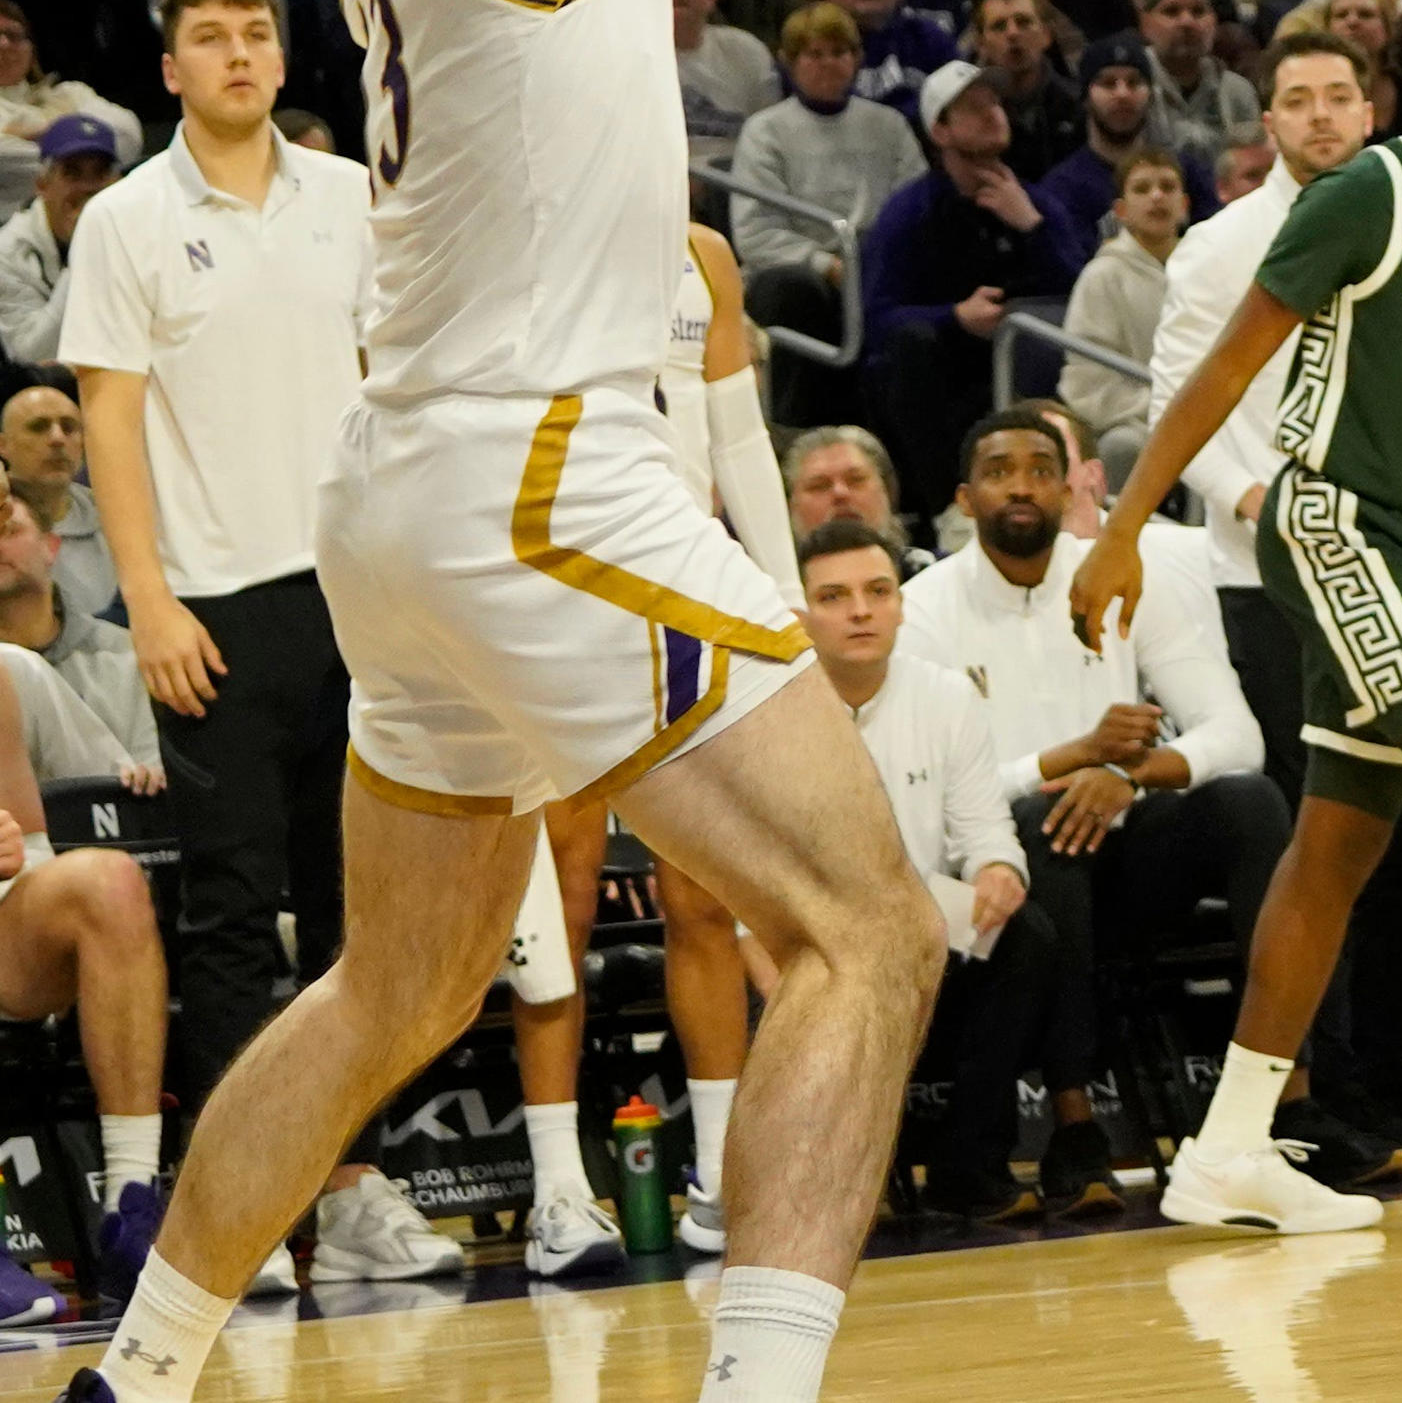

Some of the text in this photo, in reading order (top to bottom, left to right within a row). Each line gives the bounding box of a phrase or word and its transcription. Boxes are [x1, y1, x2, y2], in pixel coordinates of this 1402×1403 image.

[185, 239, 215, 273] N
[91, 802, 120, 839] N
[624, 1138, 656, 1174] G
[411, 1166, 457, 1190] BOB
